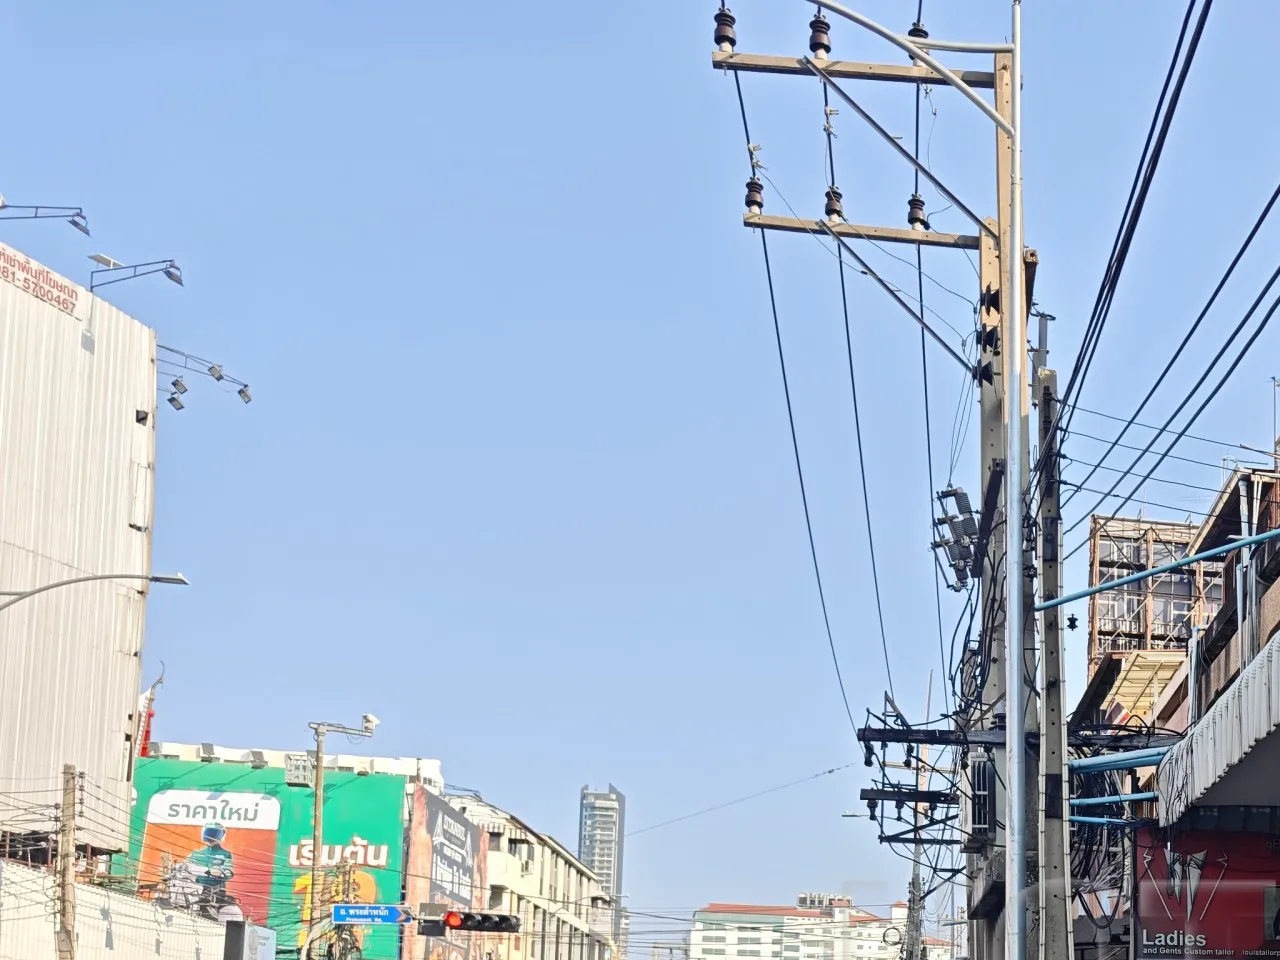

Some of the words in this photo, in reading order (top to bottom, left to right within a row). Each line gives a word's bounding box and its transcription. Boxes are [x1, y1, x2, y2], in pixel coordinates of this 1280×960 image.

[0, 265, 76, 313] 81-5700467
[167, 799, 260, 823] ราคาใหม่
[1142, 929, 1207, 947] Ladies
[1143, 947, 1157, 955] and
[1159, 947, 1182, 955] Gents
[1215, 948, 1234, 956] tailor
